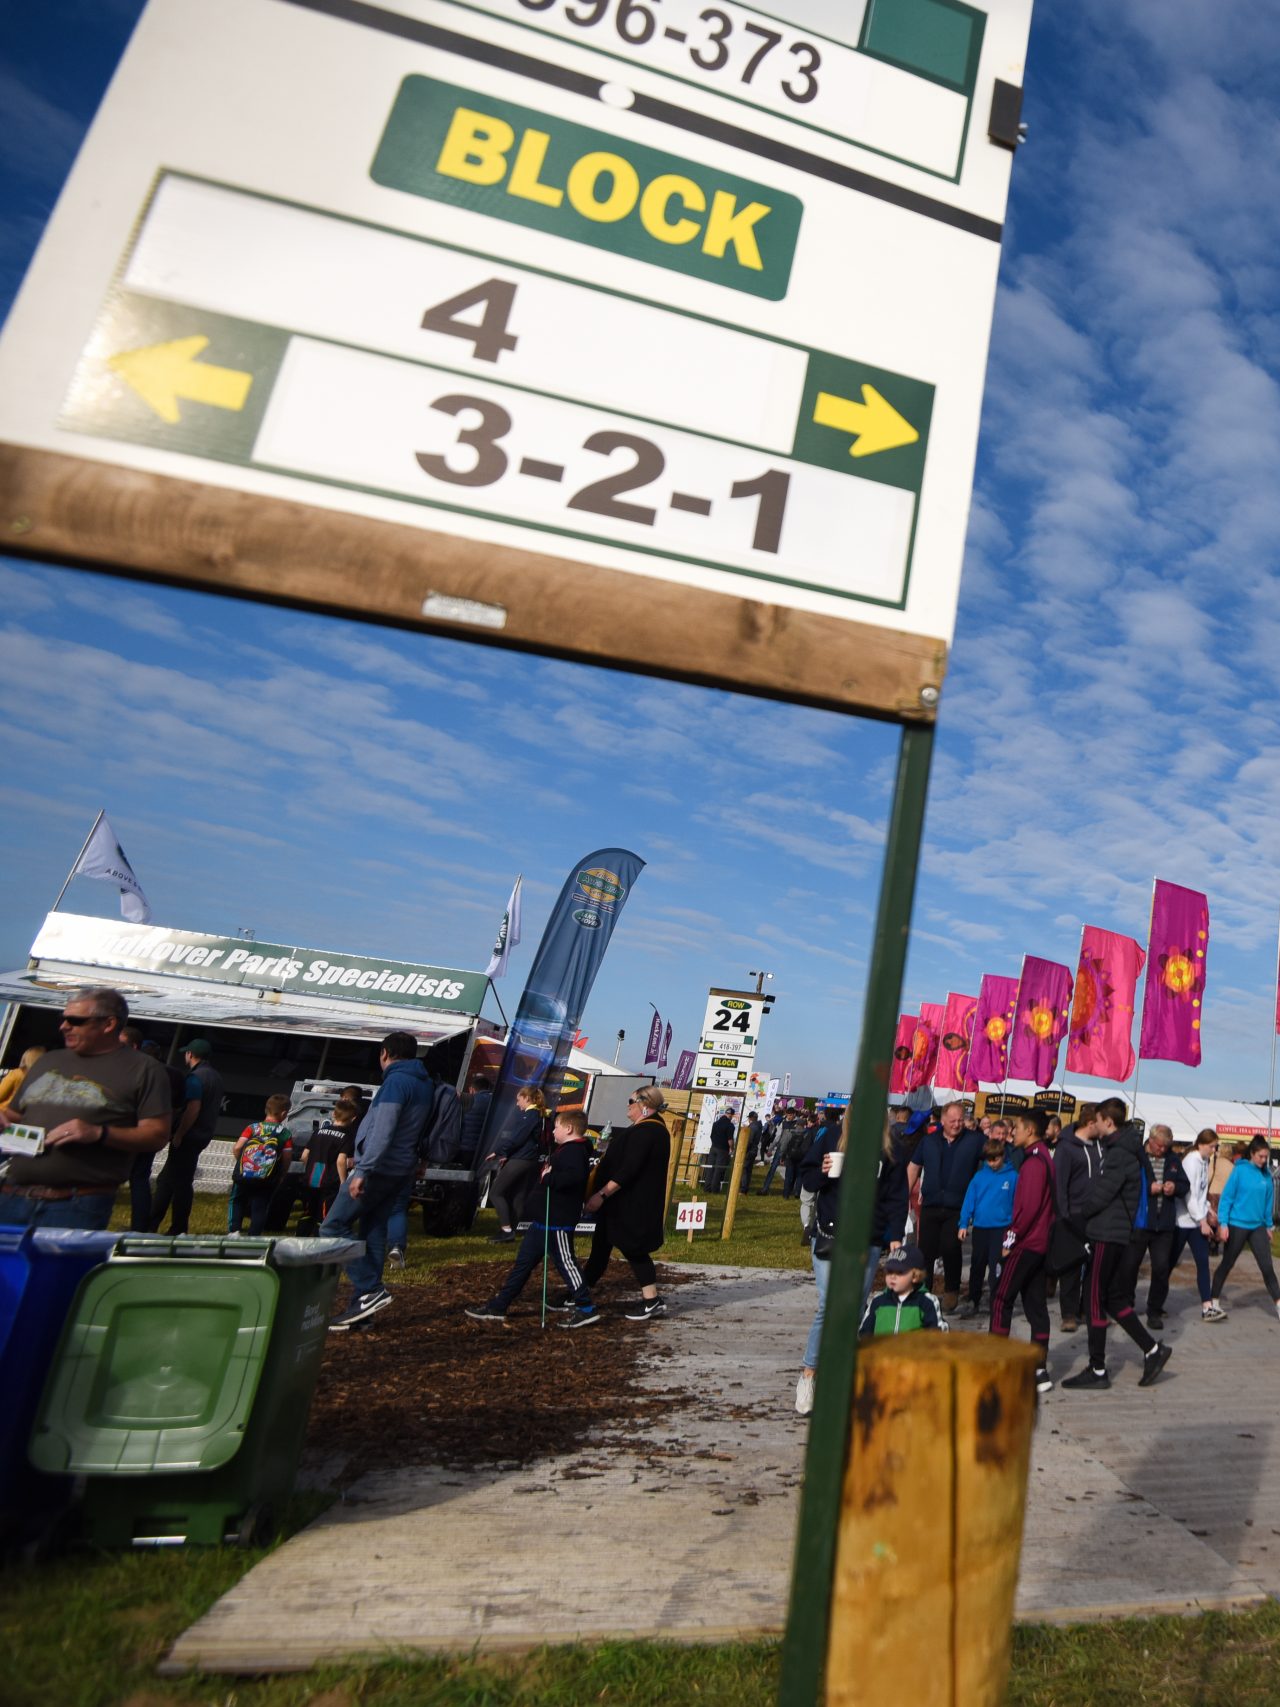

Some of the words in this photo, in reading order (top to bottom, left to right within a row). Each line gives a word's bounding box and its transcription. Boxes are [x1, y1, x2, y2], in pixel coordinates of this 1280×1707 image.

[516, 0, 823, 104] 6-373
[435, 107, 772, 271] BLOCK
[420, 279, 519, 363] 4
[414, 393, 793, 555] 3-2-1
[221, 948, 304, 979] Parts
[303, 960, 465, 1000] Specialists
[727, 1000, 746, 1009] ROW
[713, 1009, 750, 1032] 24
[719, 1043, 742, 1051] 418-397
[713, 1058, 736, 1067] BLOCK
[714, 1079, 738, 1087] 3-2-1
[679, 1208, 704, 1224] 418
